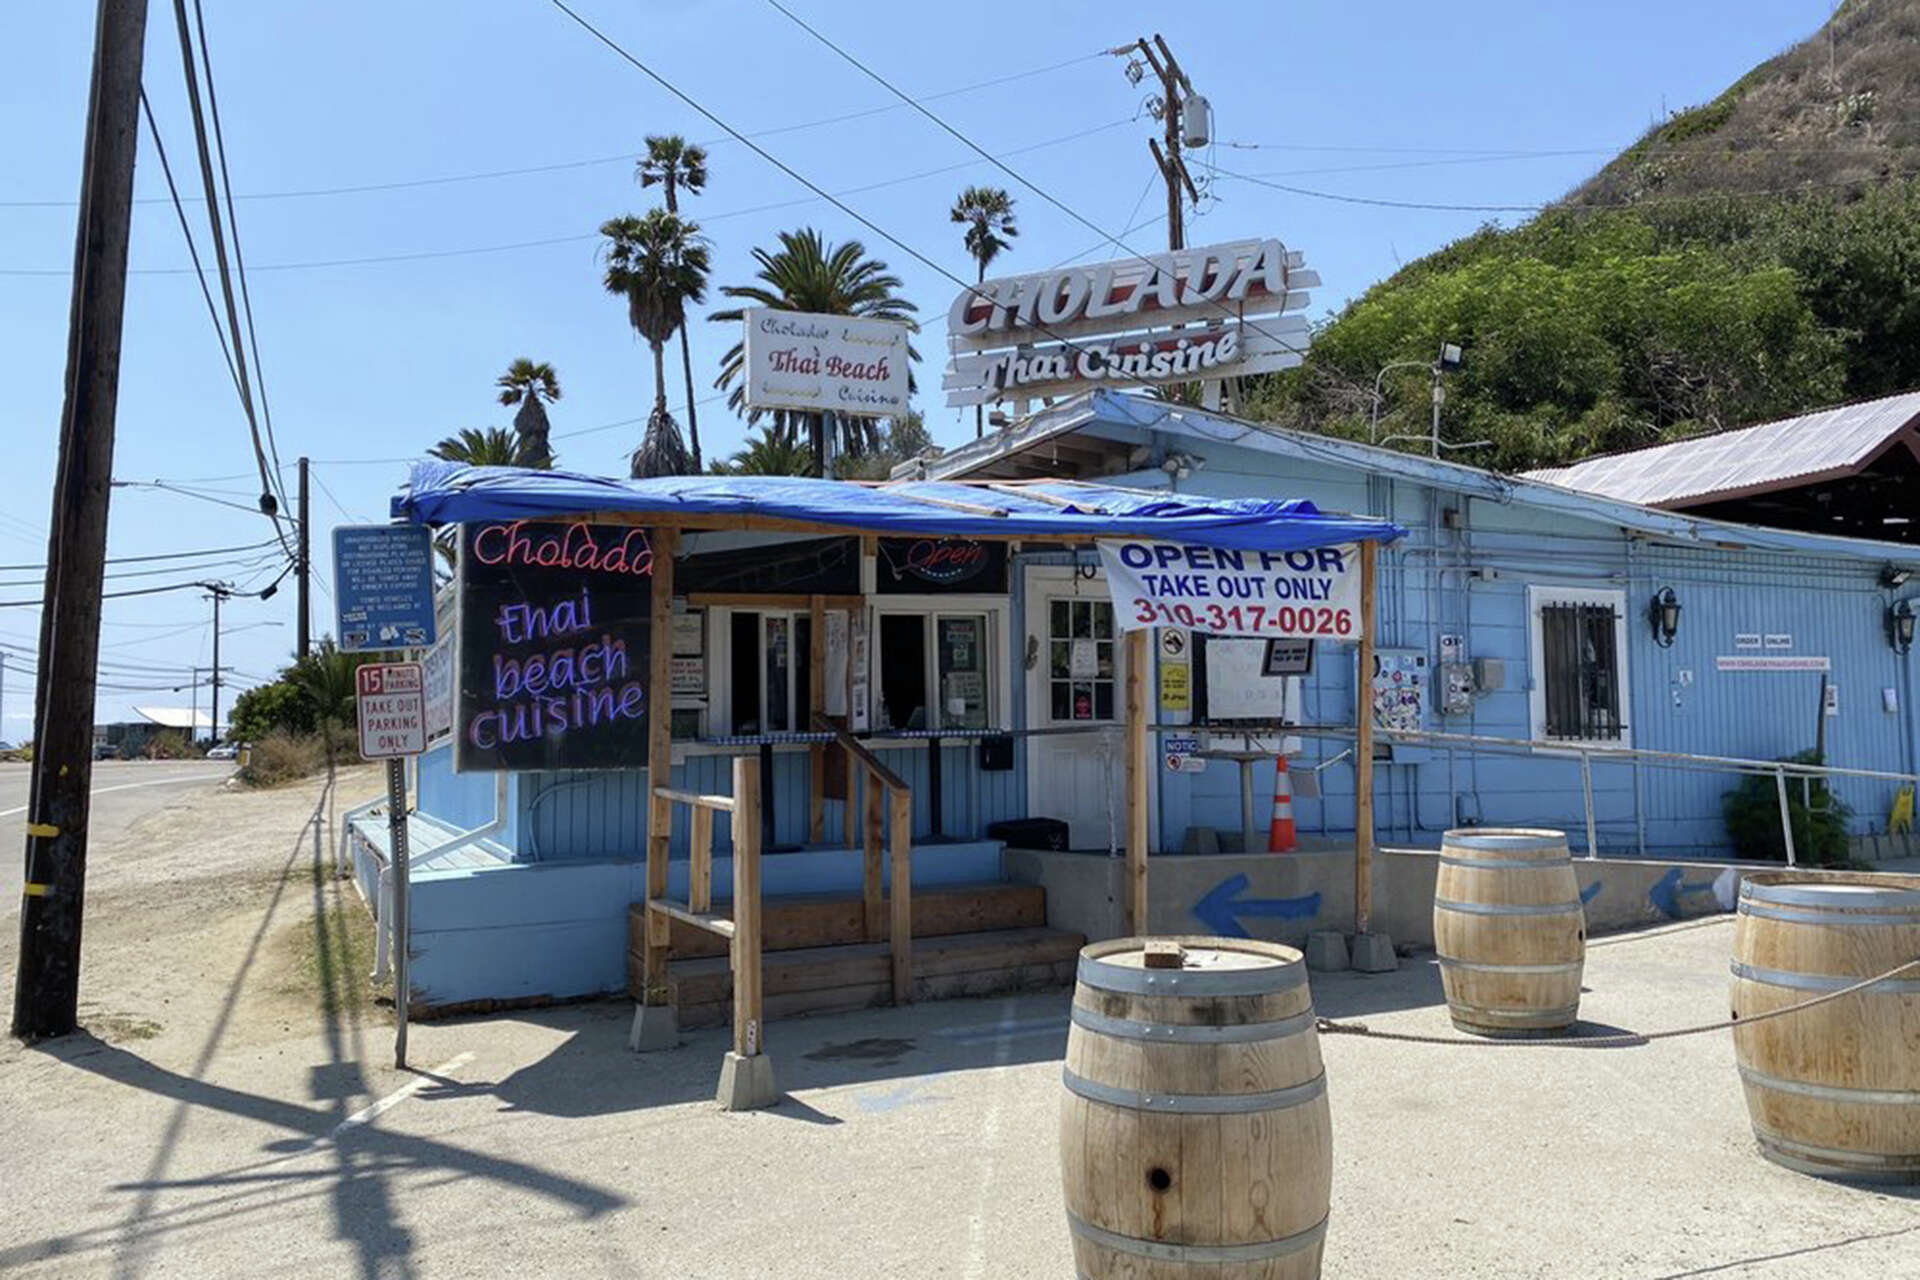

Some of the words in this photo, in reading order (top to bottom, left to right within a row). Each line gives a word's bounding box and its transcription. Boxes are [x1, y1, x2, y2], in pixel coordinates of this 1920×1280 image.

[949, 238, 1289, 336] CHOLADA
[769, 346, 821, 375] Thai
[825, 355, 890, 382] Beach
[981, 349, 1072, 396] Thai
[1076, 330, 1242, 380] Cuisine
[474, 520, 653, 575] Cholada
[1120, 543, 1245, 571] OPEN
[1261, 548, 1345, 573] FOR
[1142, 574, 1210, 597] TAKE
[1217, 576, 1265, 599] OUT
[1274, 577, 1332, 600] ONLY
[496, 587, 592, 644] thai
[1134, 598, 1352, 635] 310-317-0026
[362, 670, 380, 692] 15
[494, 634, 626, 700] beach
[365, 699, 393, 714] TAKE
[396, 698, 418, 713] OUT
[368, 716, 417, 732] PARKING
[469, 681, 644, 749] cuisine
[378, 734, 408, 749] ONLY
[1167, 741, 1198, 752] NOTIC
